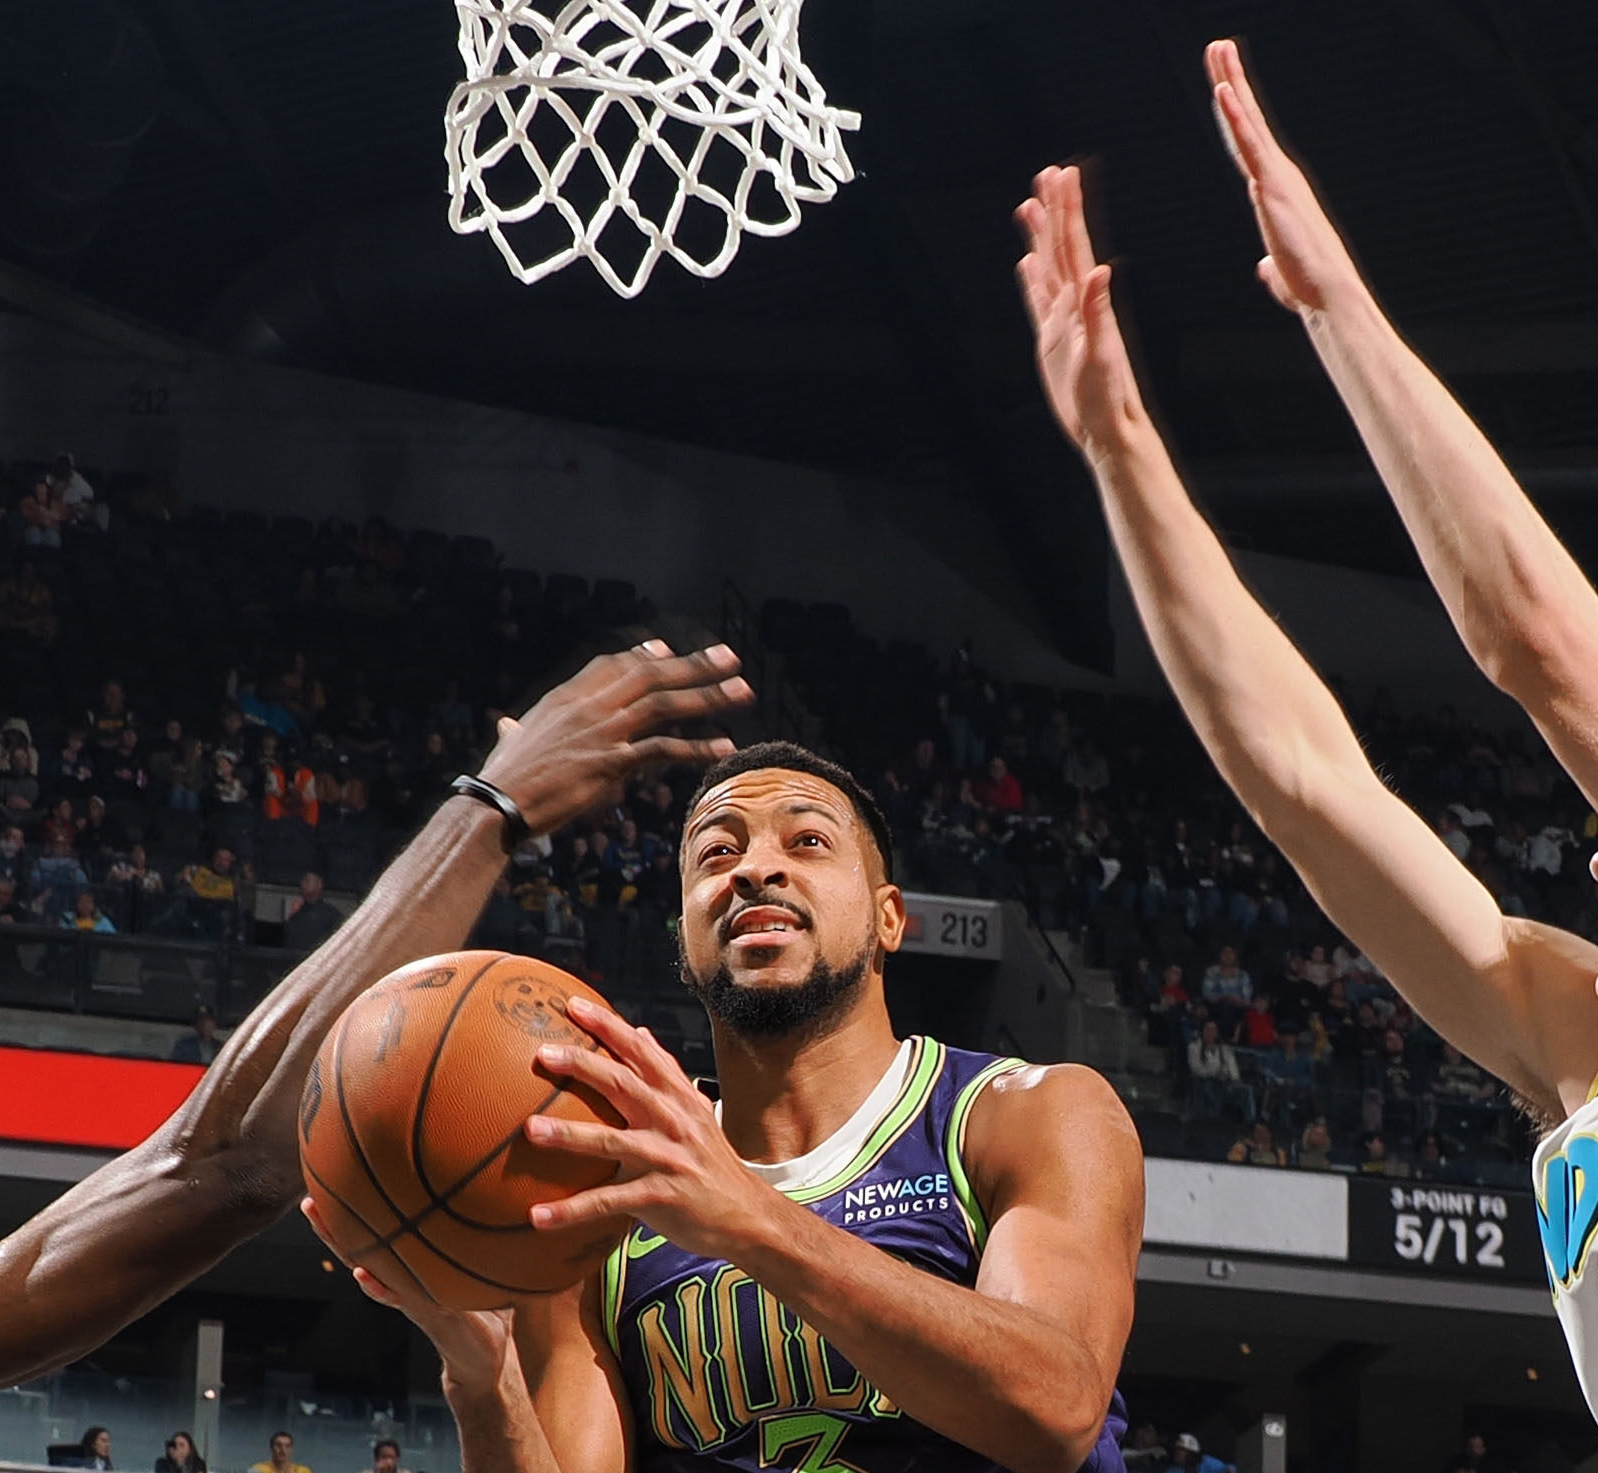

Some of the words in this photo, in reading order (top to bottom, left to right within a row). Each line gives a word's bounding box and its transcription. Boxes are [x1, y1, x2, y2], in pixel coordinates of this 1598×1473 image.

[941, 912, 987, 948] 213
[845, 1173, 949, 1210] NEWAGE
[1390, 1186, 1475, 1218] 3-POINT
[1479, 1194, 1508, 1220] FG
[845, 1196, 949, 1225] PRODUCTS
[1394, 1213, 1506, 1268] 5/12
[637, 1264, 903, 1452] NOL
